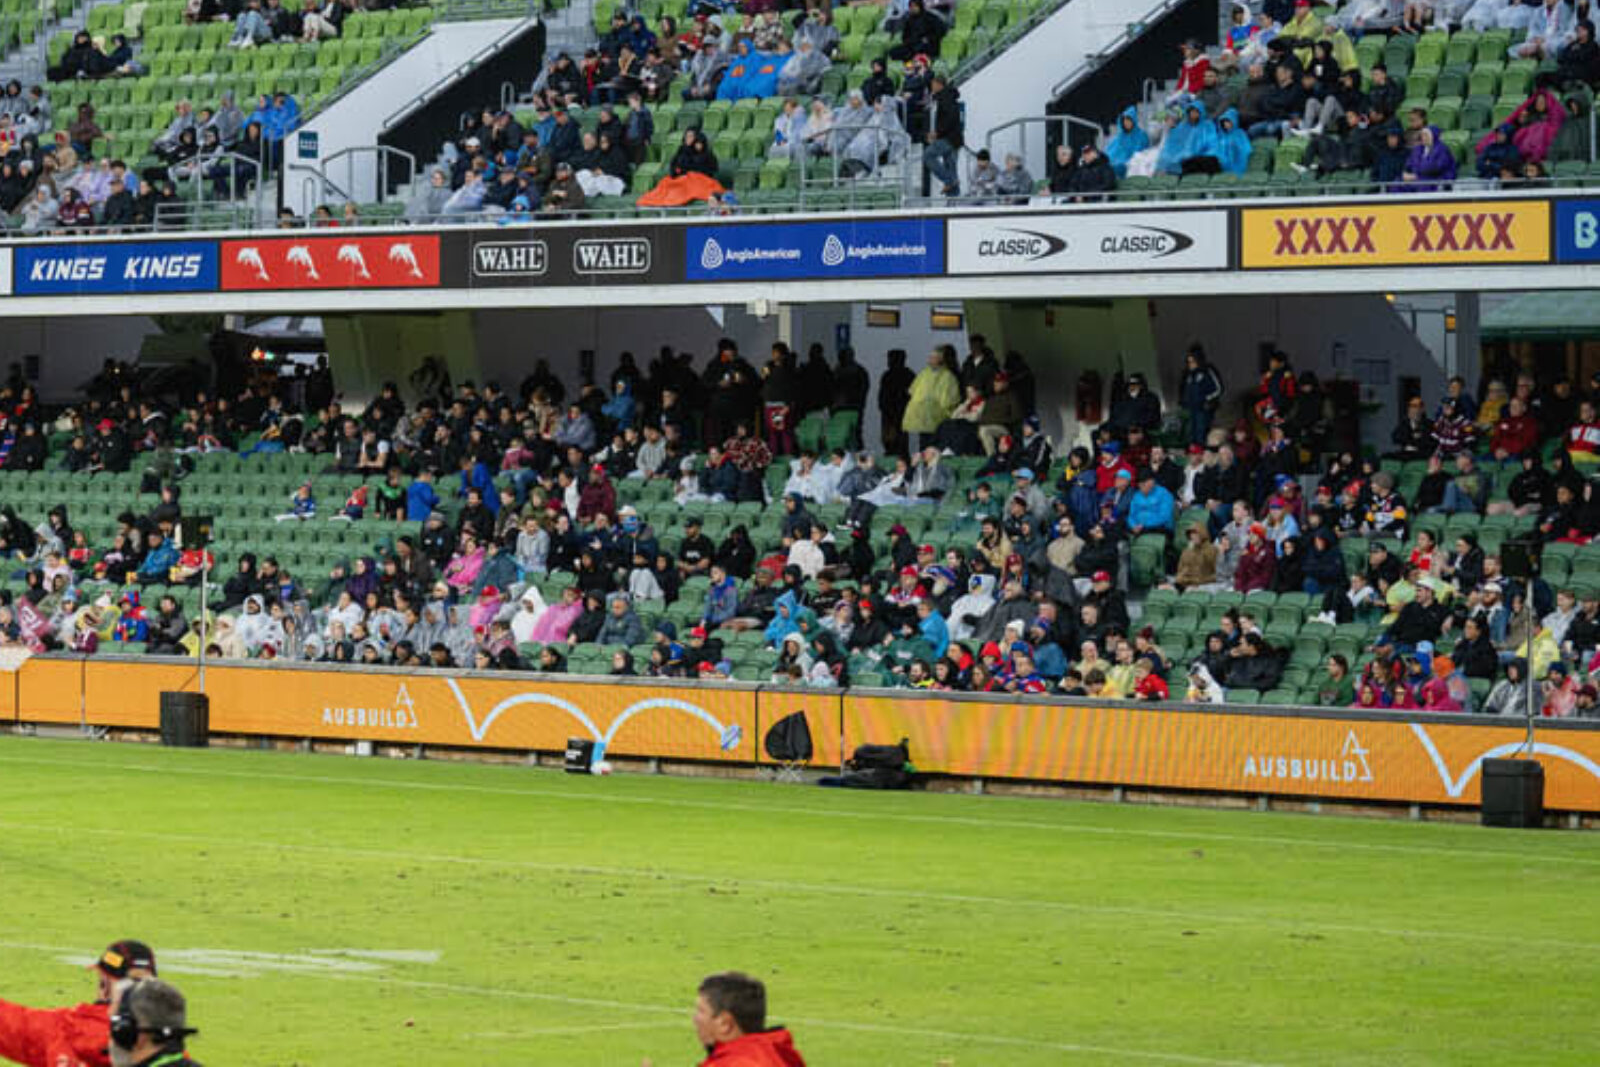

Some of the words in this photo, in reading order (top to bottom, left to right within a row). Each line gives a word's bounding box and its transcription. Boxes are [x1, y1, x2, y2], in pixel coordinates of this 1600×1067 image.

[978, 238, 1042, 257] CLASSIC
[1100, 235, 1167, 253] CLASSIC
[1273, 216, 1377, 255] XXXX
[1408, 213, 1515, 252] XXXX
[30, 257, 107, 281] KINGS
[123, 254, 202, 279] KINGS
[478, 246, 542, 271] WAHL
[578, 244, 646, 269] WAHL
[1244, 754, 1357, 782] AUSBUILD
